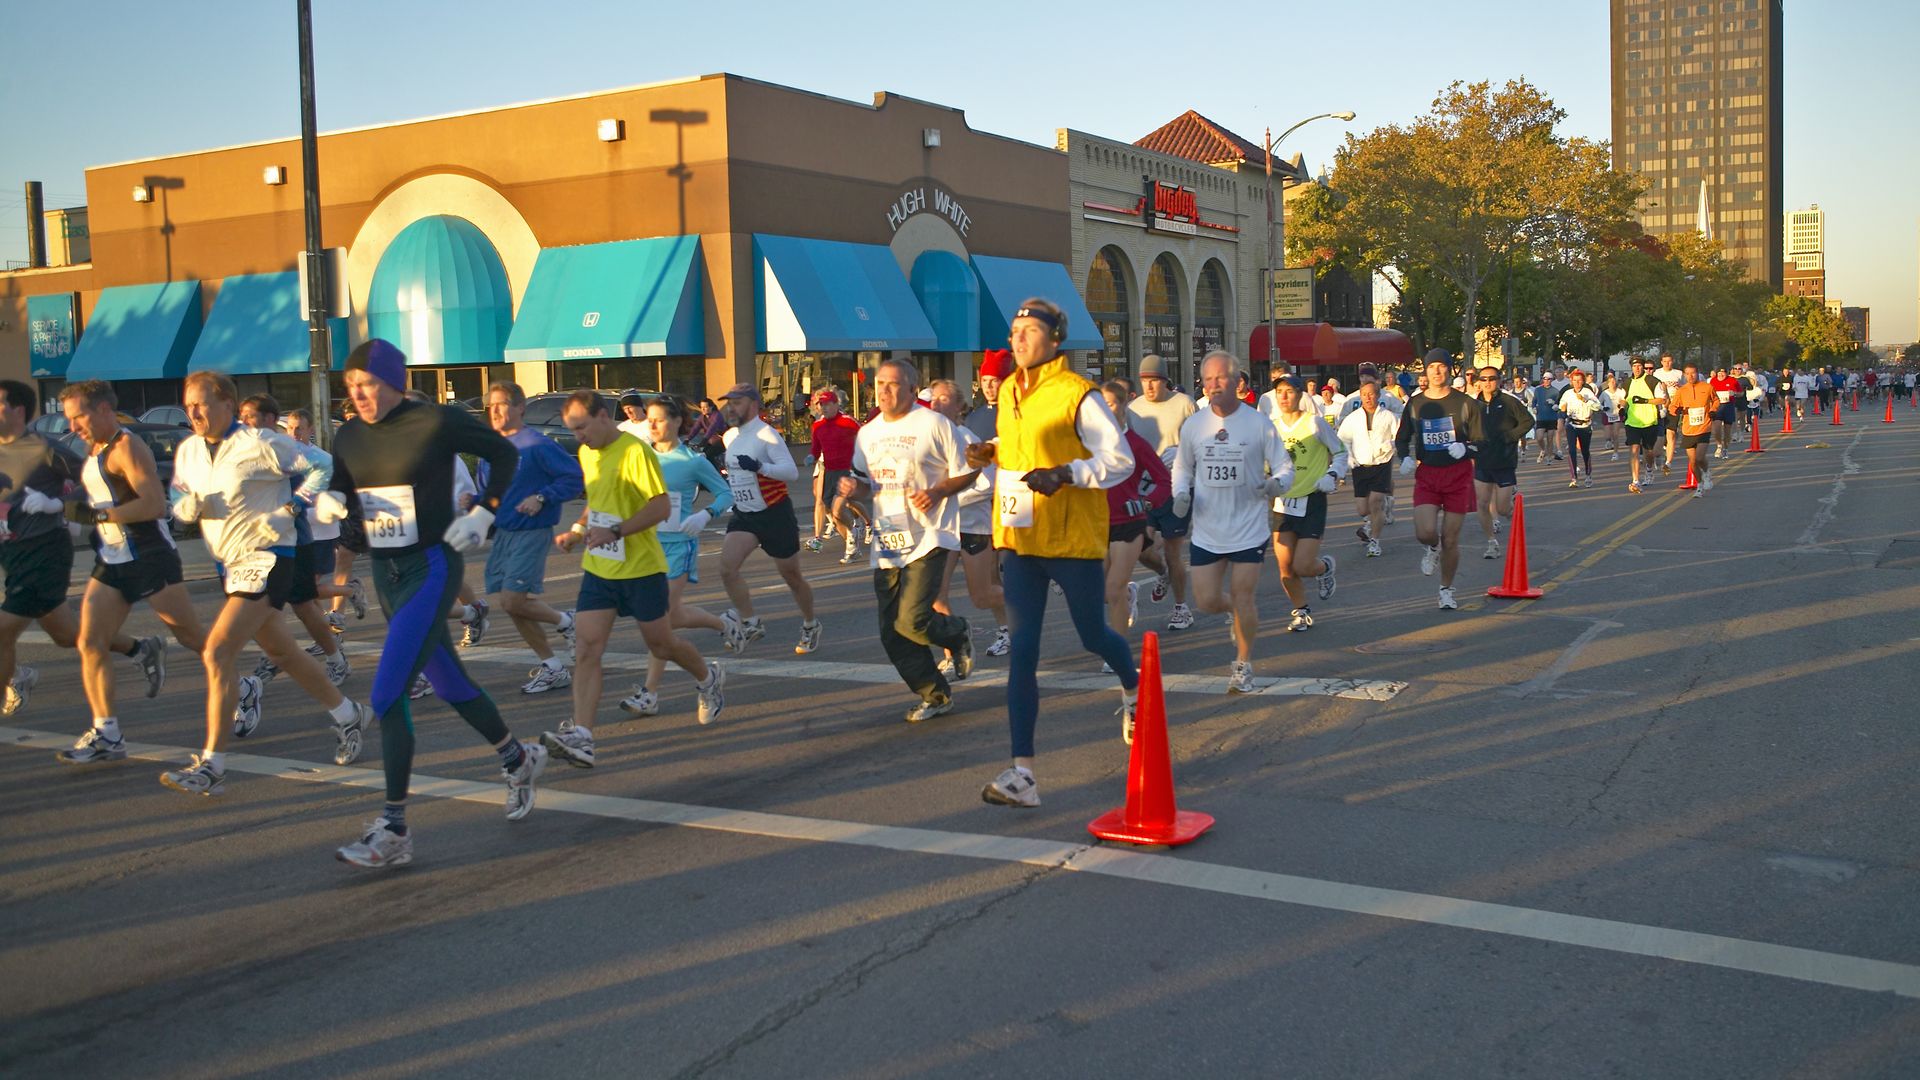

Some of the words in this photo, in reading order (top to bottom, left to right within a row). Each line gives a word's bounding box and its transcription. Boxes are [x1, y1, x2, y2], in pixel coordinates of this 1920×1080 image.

[886, 187, 926, 231] HUGH
[934, 188, 972, 238] WHITE
[1155, 218, 1195, 234] MOTORCYCLES
[862, 340, 888, 348] HONDA
[562, 347, 604, 358] HONDA
[1426, 432, 1450, 444] 5689
[1207, 465, 1237, 481] 7334
[369, 518, 407, 538] 7391
[877, 533, 906, 550] 5599
